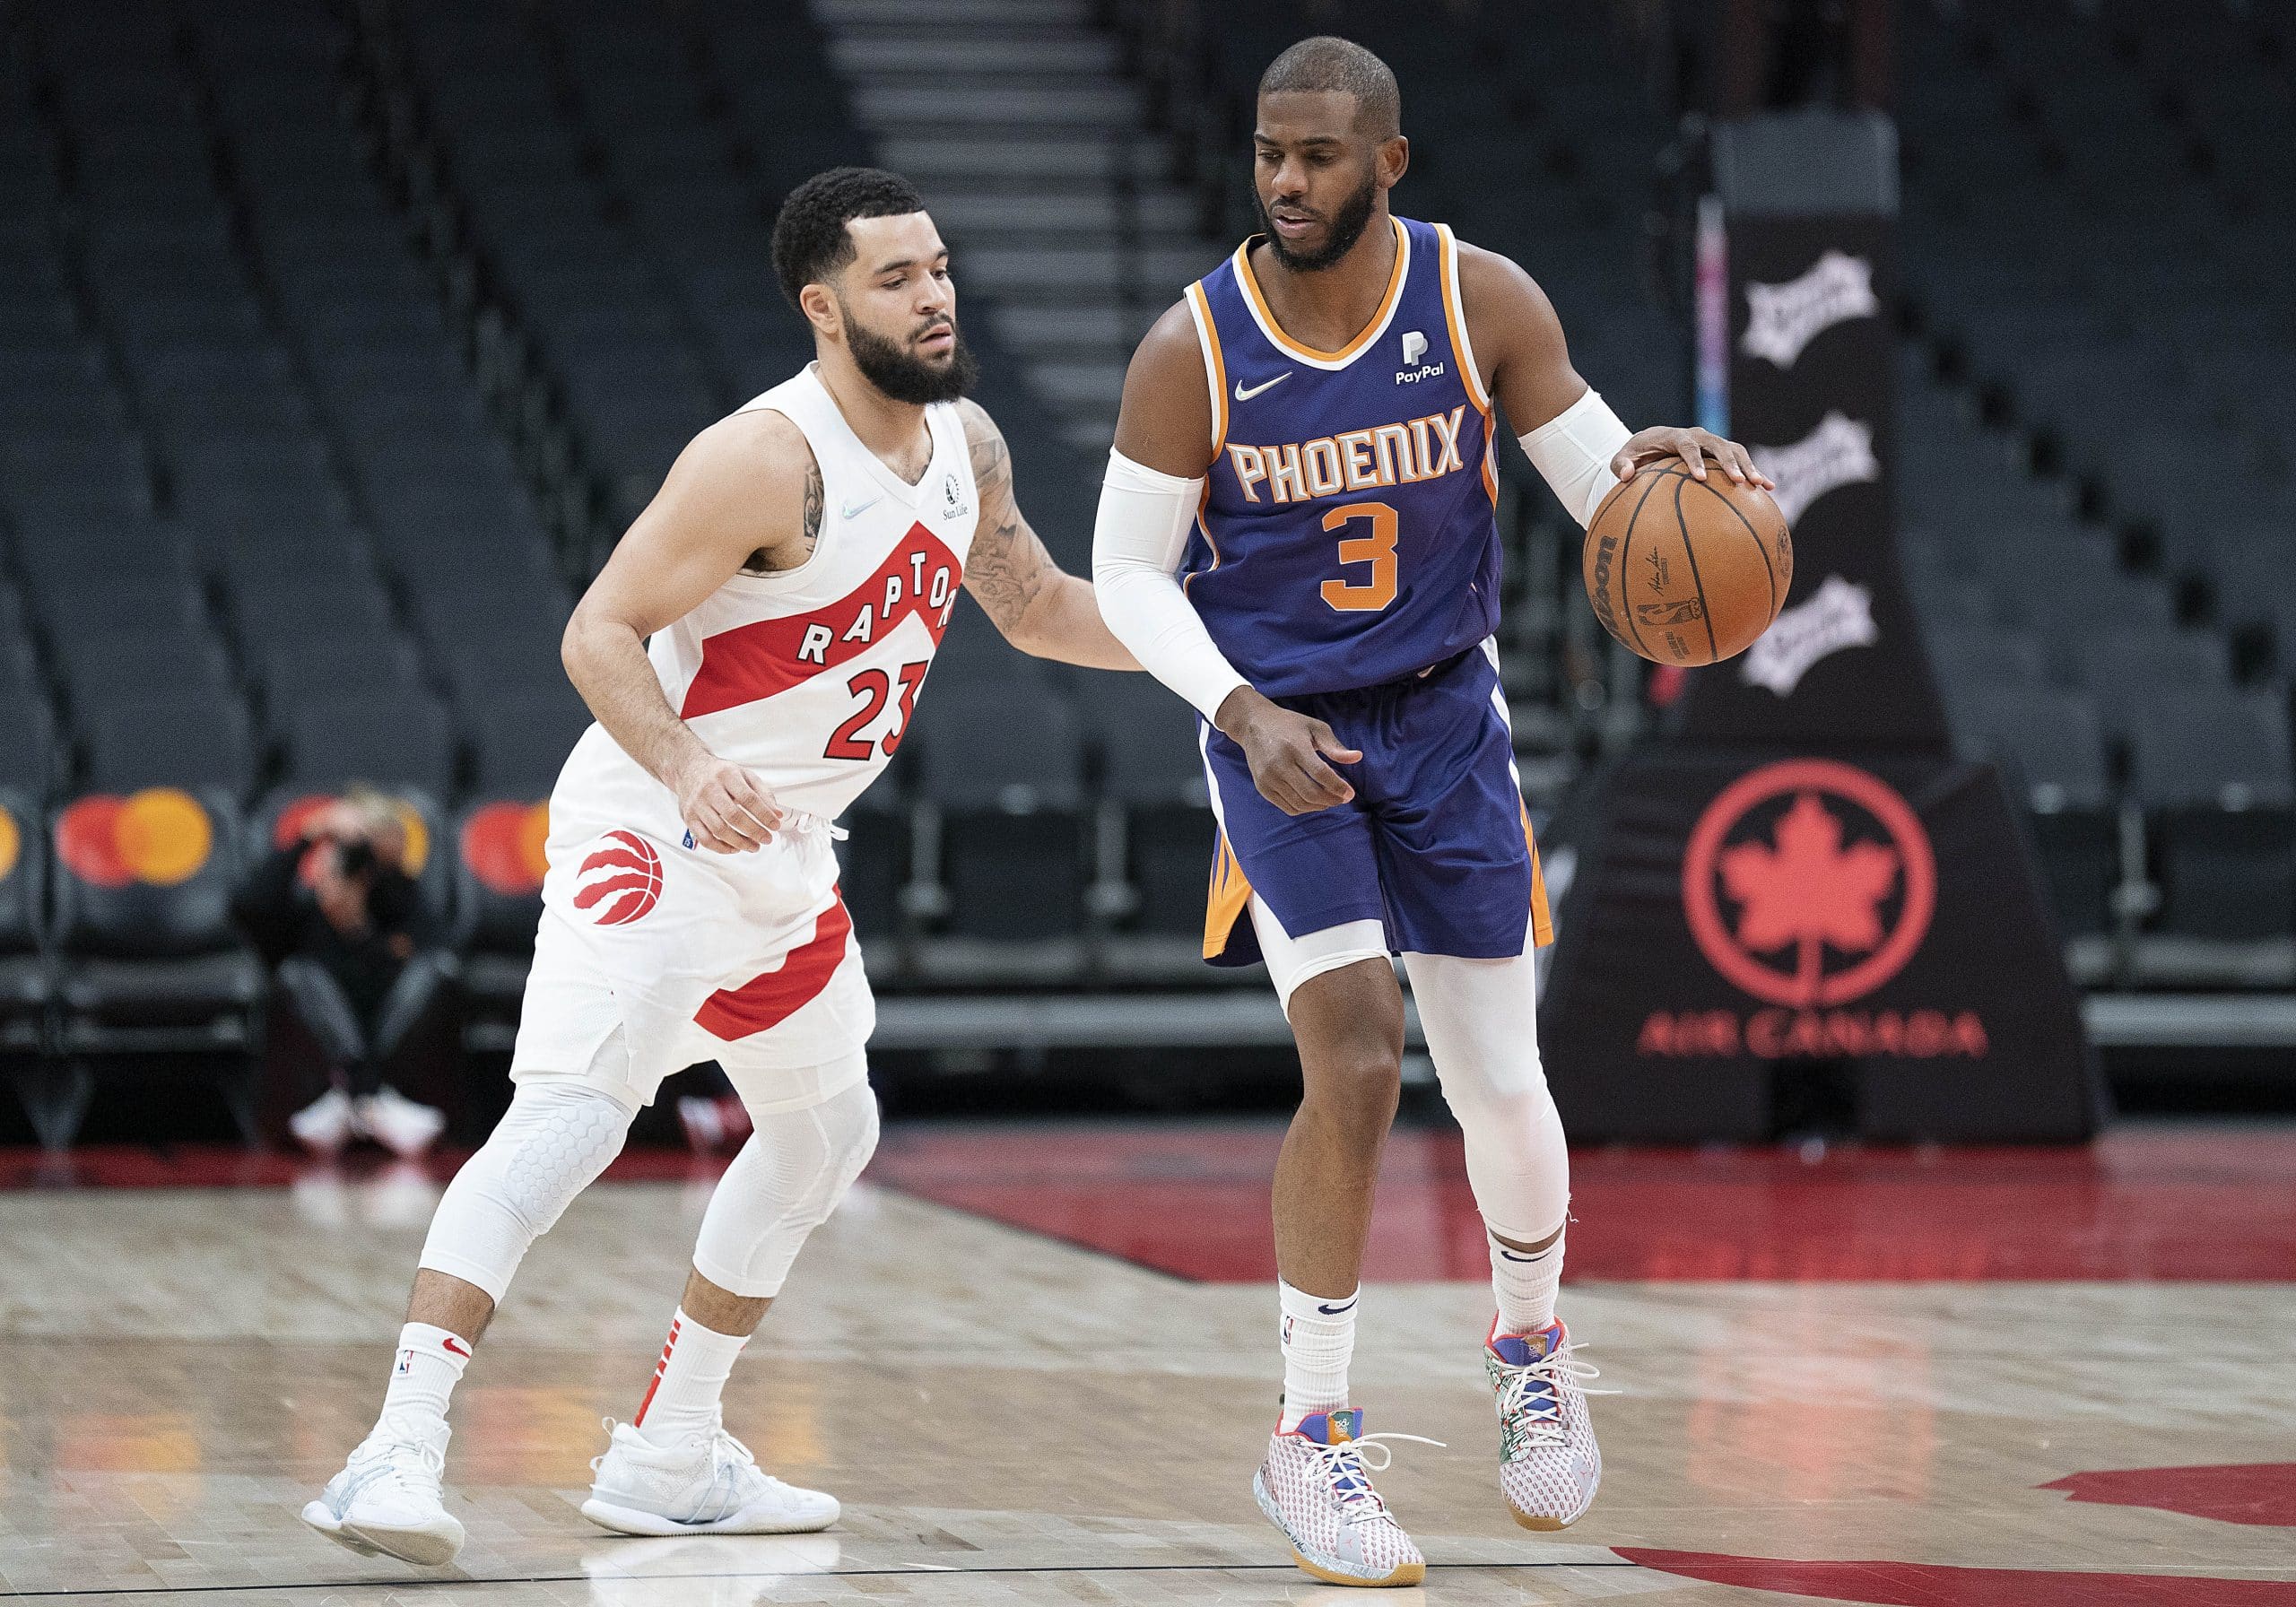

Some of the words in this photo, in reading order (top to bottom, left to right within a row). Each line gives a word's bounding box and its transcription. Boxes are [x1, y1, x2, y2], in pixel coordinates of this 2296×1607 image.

[1396, 361, 1444, 386] PayPal
[1225, 404, 1465, 503] PHOENIX
[943, 508, 956, 521] Sun
[955, 502, 968, 517] Life
[1320, 501, 1399, 612] 3
[822, 660, 929, 761] 23
